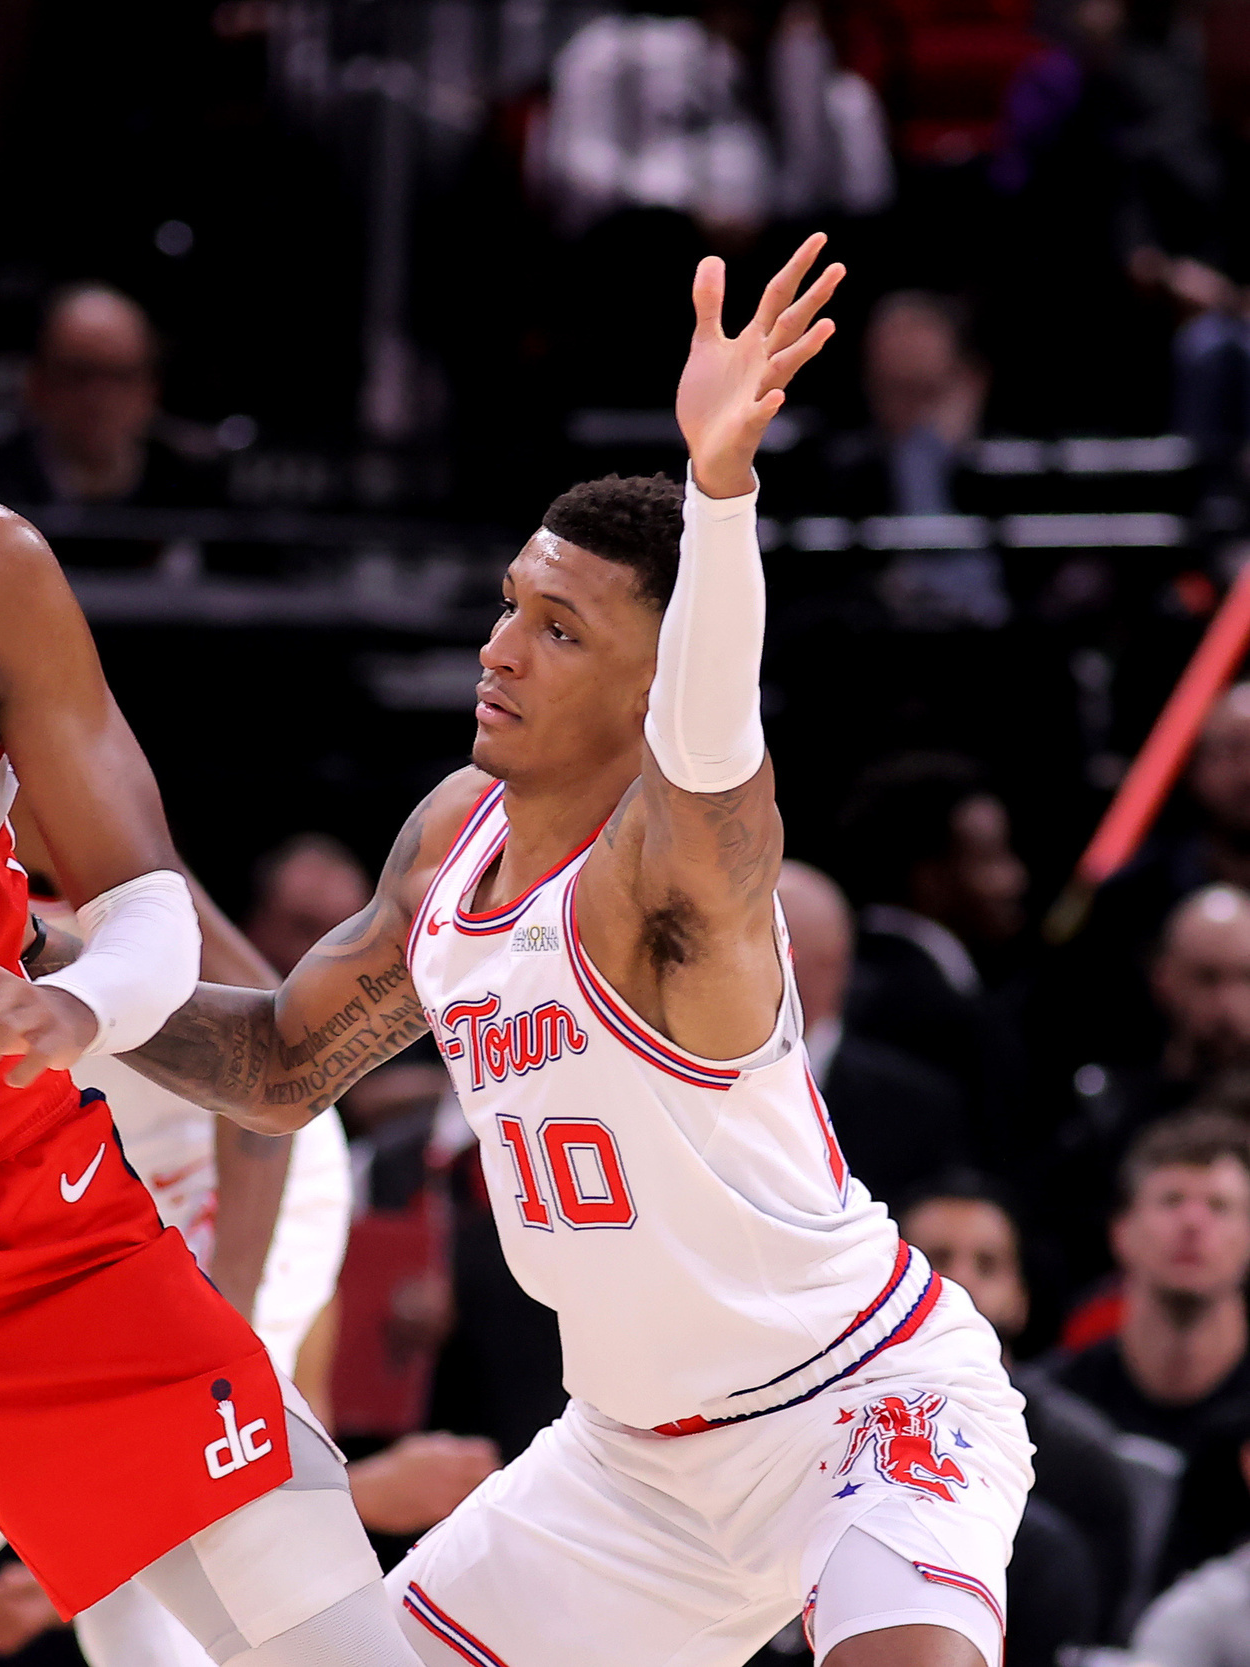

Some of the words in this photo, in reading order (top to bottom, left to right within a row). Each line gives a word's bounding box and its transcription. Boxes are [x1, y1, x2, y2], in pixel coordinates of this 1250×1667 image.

[379, 995, 423, 1029] And
[423, 991, 588, 1092] -Town
[495, 1113, 638, 1233] 10
[203, 1399, 273, 1480] dc
